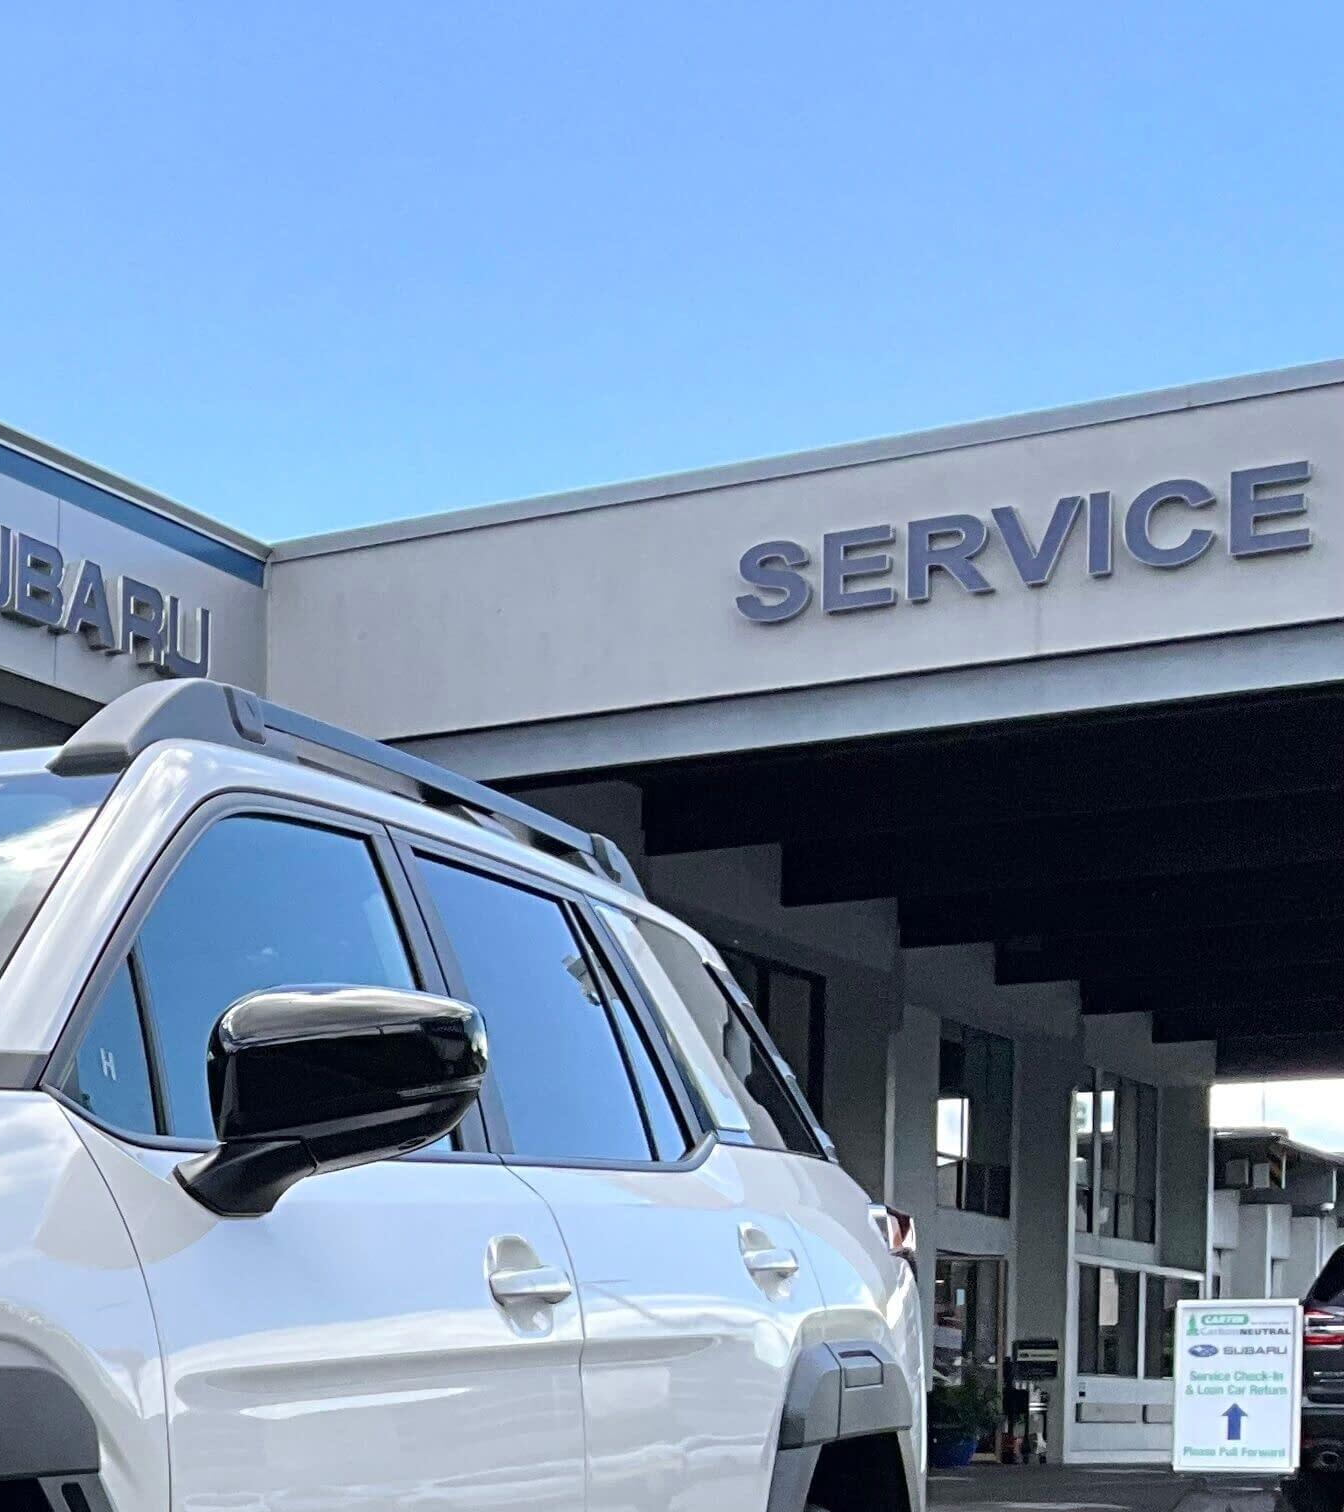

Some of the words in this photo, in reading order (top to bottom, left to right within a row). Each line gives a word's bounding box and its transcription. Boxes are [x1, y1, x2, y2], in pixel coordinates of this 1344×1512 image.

[735, 460, 1313, 623] SERVICE
[1223, 1346, 1288, 1355] SUBARU
[1190, 1370, 1231, 1381] Service
[1234, 1370, 1284, 1381] Check-In
[1185, 1385, 1194, 1395] &
[1197, 1385, 1224, 1395] Loan
[1227, 1385, 1245, 1395] Car
[1250, 1385, 1288, 1395] Return
[1183, 1446, 1216, 1456] Please
[1219, 1446, 1238, 1456] Pull
[1242, 1447, 1285, 1457] Forward
